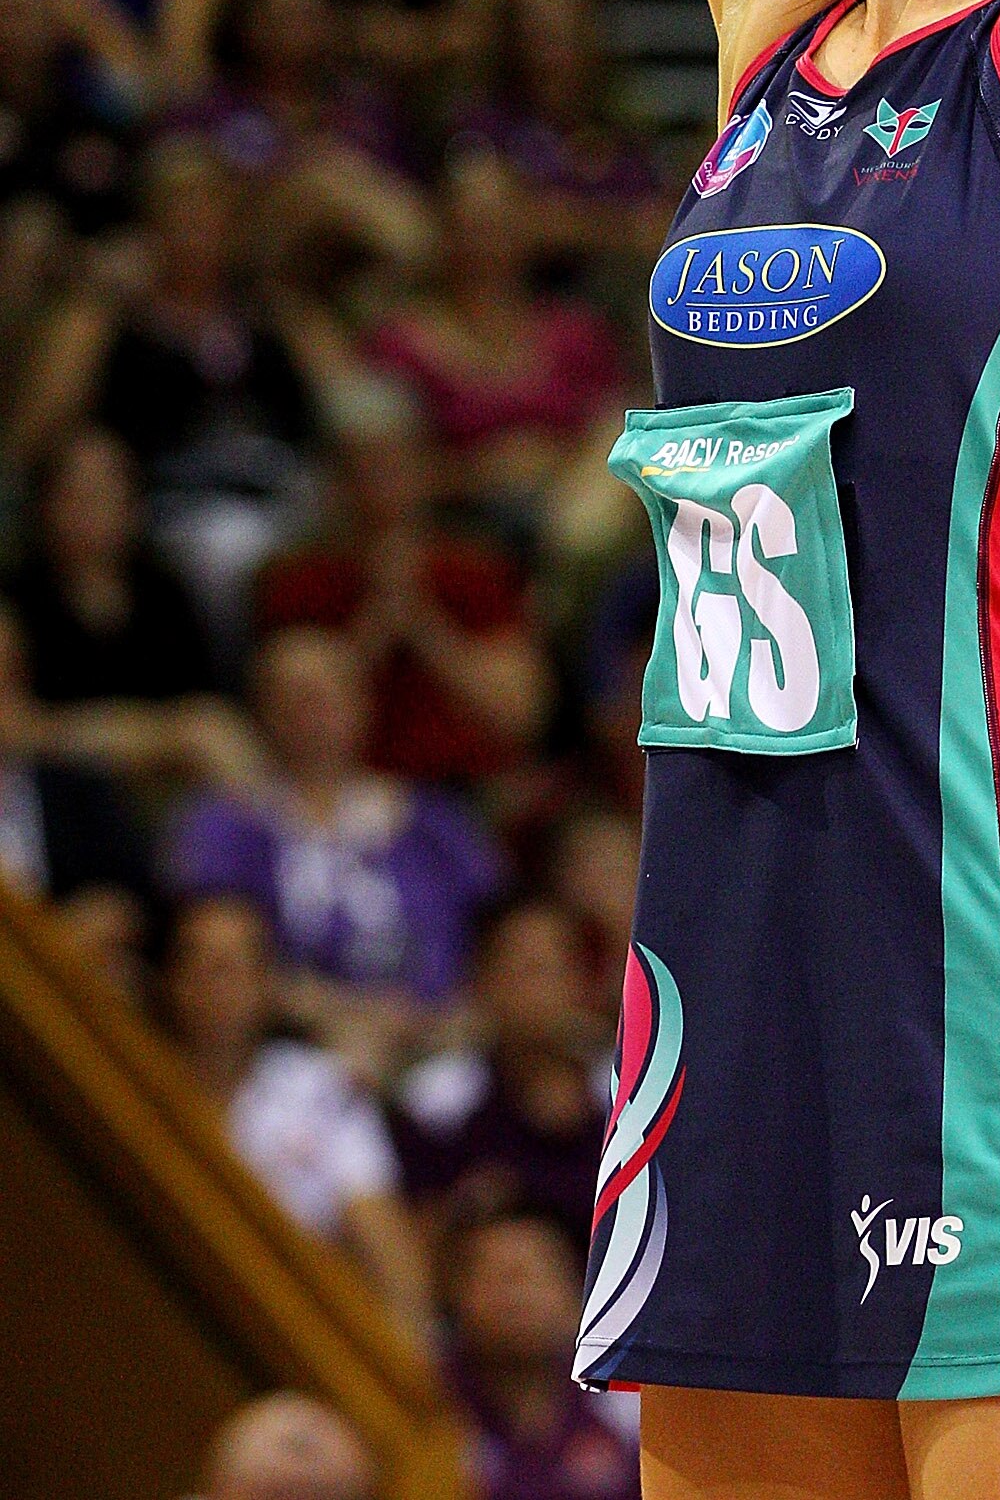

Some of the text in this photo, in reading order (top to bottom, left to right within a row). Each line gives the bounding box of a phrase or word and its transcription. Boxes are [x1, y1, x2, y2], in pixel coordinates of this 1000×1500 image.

[667, 238, 845, 306] JASON
[688, 305, 818, 332] BEDDING
[651, 437, 723, 468] RACV
[667, 483, 821, 733] GS
[885, 1215, 965, 1266] VIS
